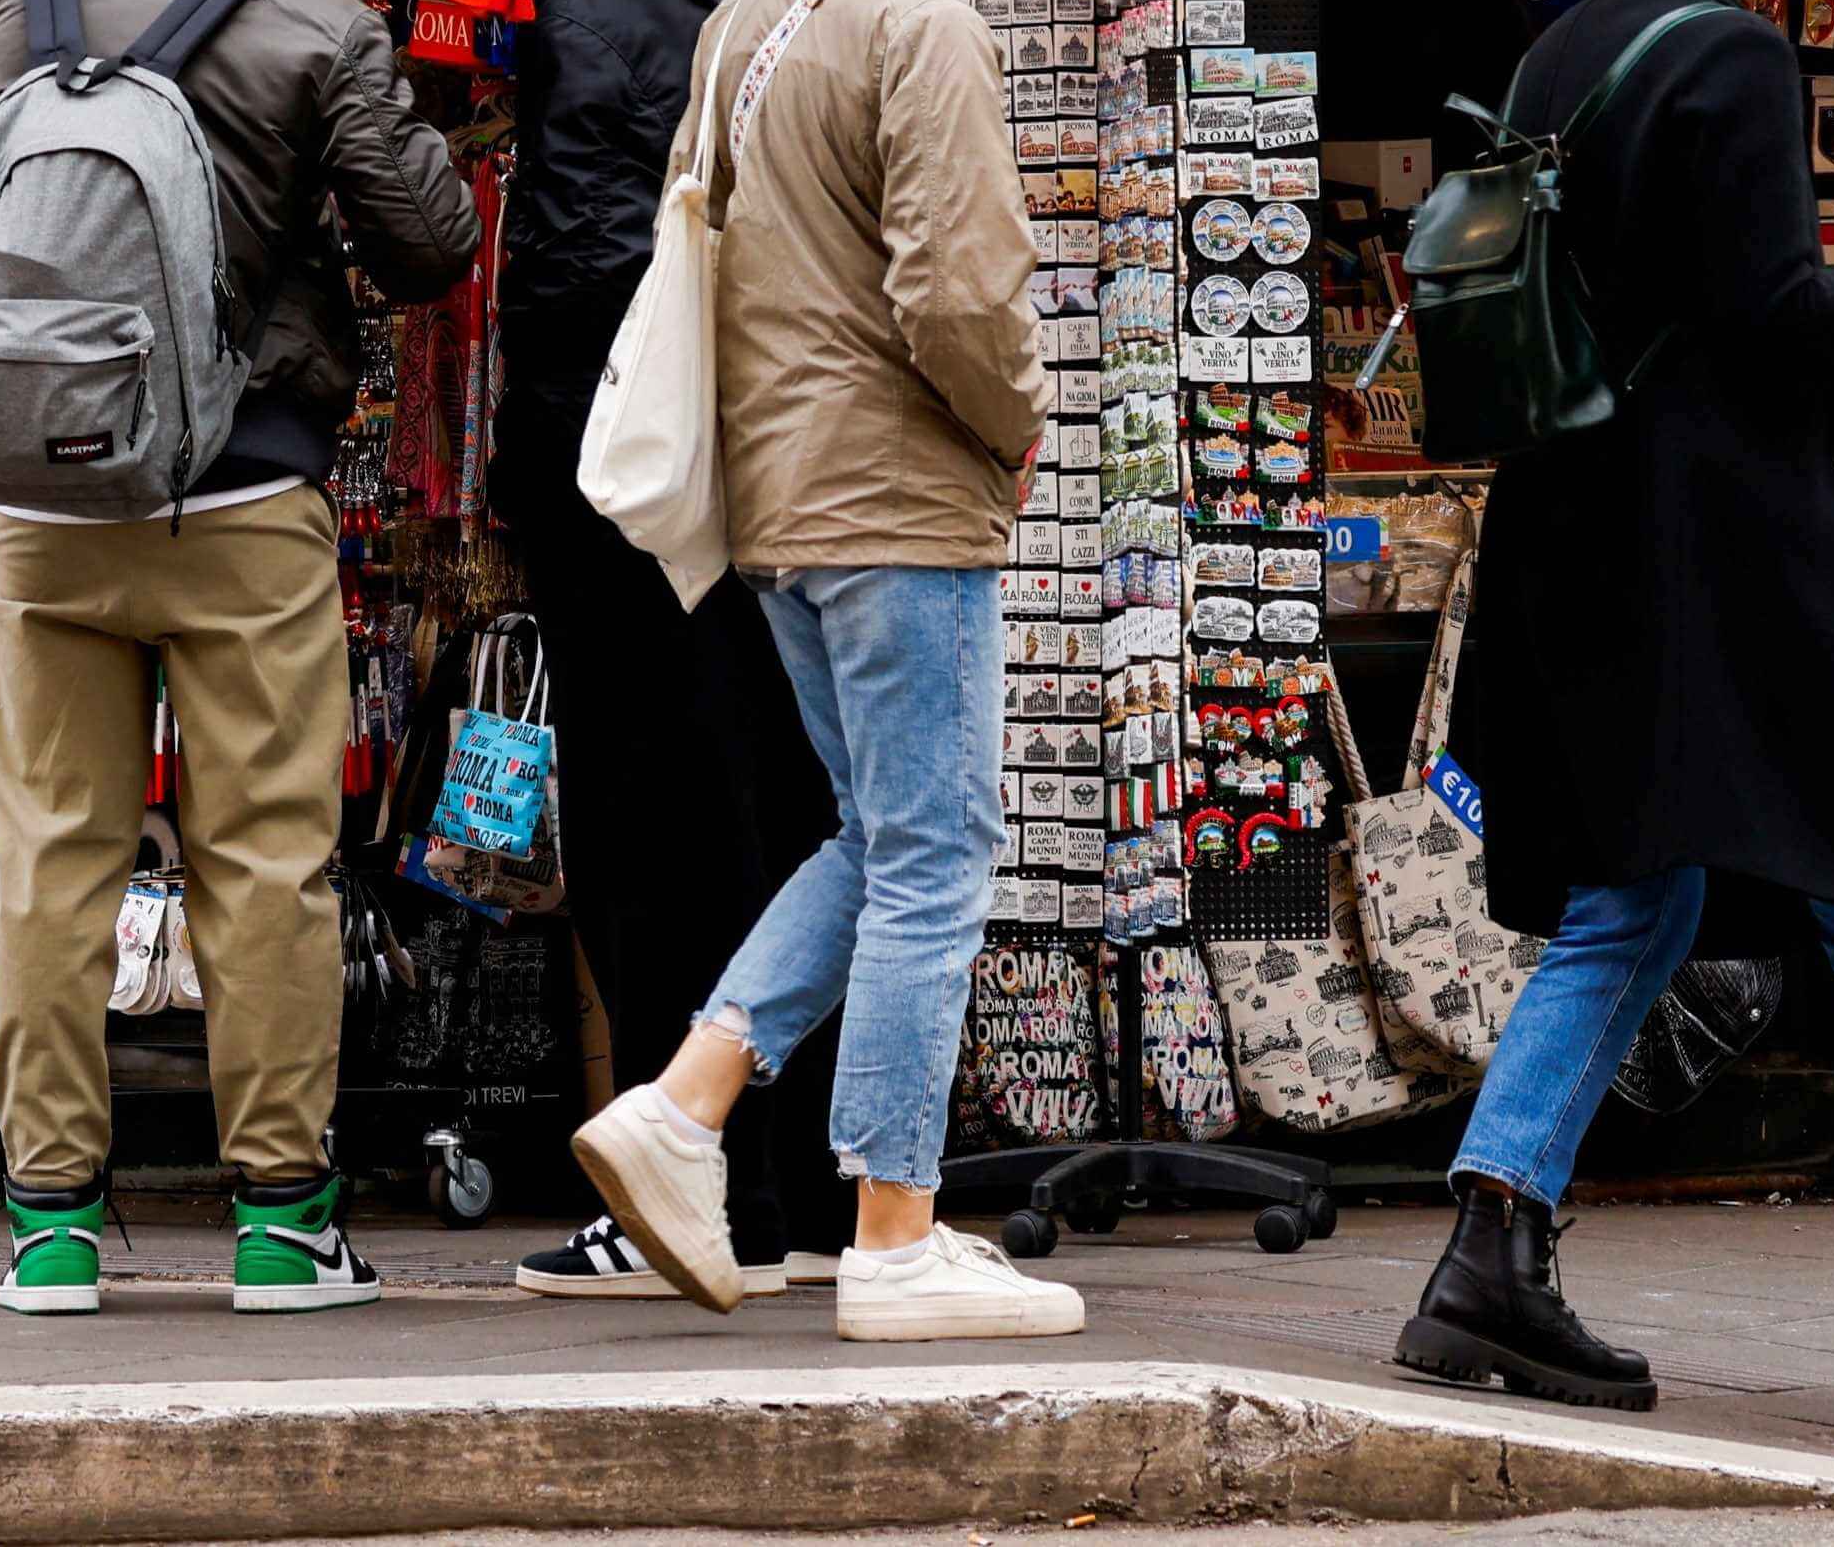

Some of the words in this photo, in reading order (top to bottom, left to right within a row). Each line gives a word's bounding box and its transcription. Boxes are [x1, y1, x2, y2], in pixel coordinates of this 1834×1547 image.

[1197, 130, 1251, 143] ROMA
[1263, 130, 1317, 150] ROMA
[1201, 358, 1239, 369] VERITAS
[1264, 358, 1302, 369] VERITAS
[1209, 419, 1236, 431] ROMA
[1269, 426, 1294, 439] ROMA
[1209, 467, 1236, 479] ROMA
[1271, 472, 1299, 483] ROMA
[1033, 525, 1047, 538] STI
[1075, 528, 1088, 541] STI
[1029, 542, 1053, 556] CAZZI
[1071, 545, 1096, 559] CAZZI
[1021, 590, 1059, 603] ROMA
[1064, 592, 1101, 606] ROMA
[473, 795, 515, 825] ROMA
[1026, 826, 1063, 837] ROMA
[1068, 831, 1104, 842] ROMA
[1031, 837, 1057, 846] CAPUT
[1071, 842, 1098, 852] CAPUT
[1027, 845, 1062, 856] MUNDI
[1068, 851, 1103, 862] MUNDI
[481, 1086, 527, 1105] TREVI
